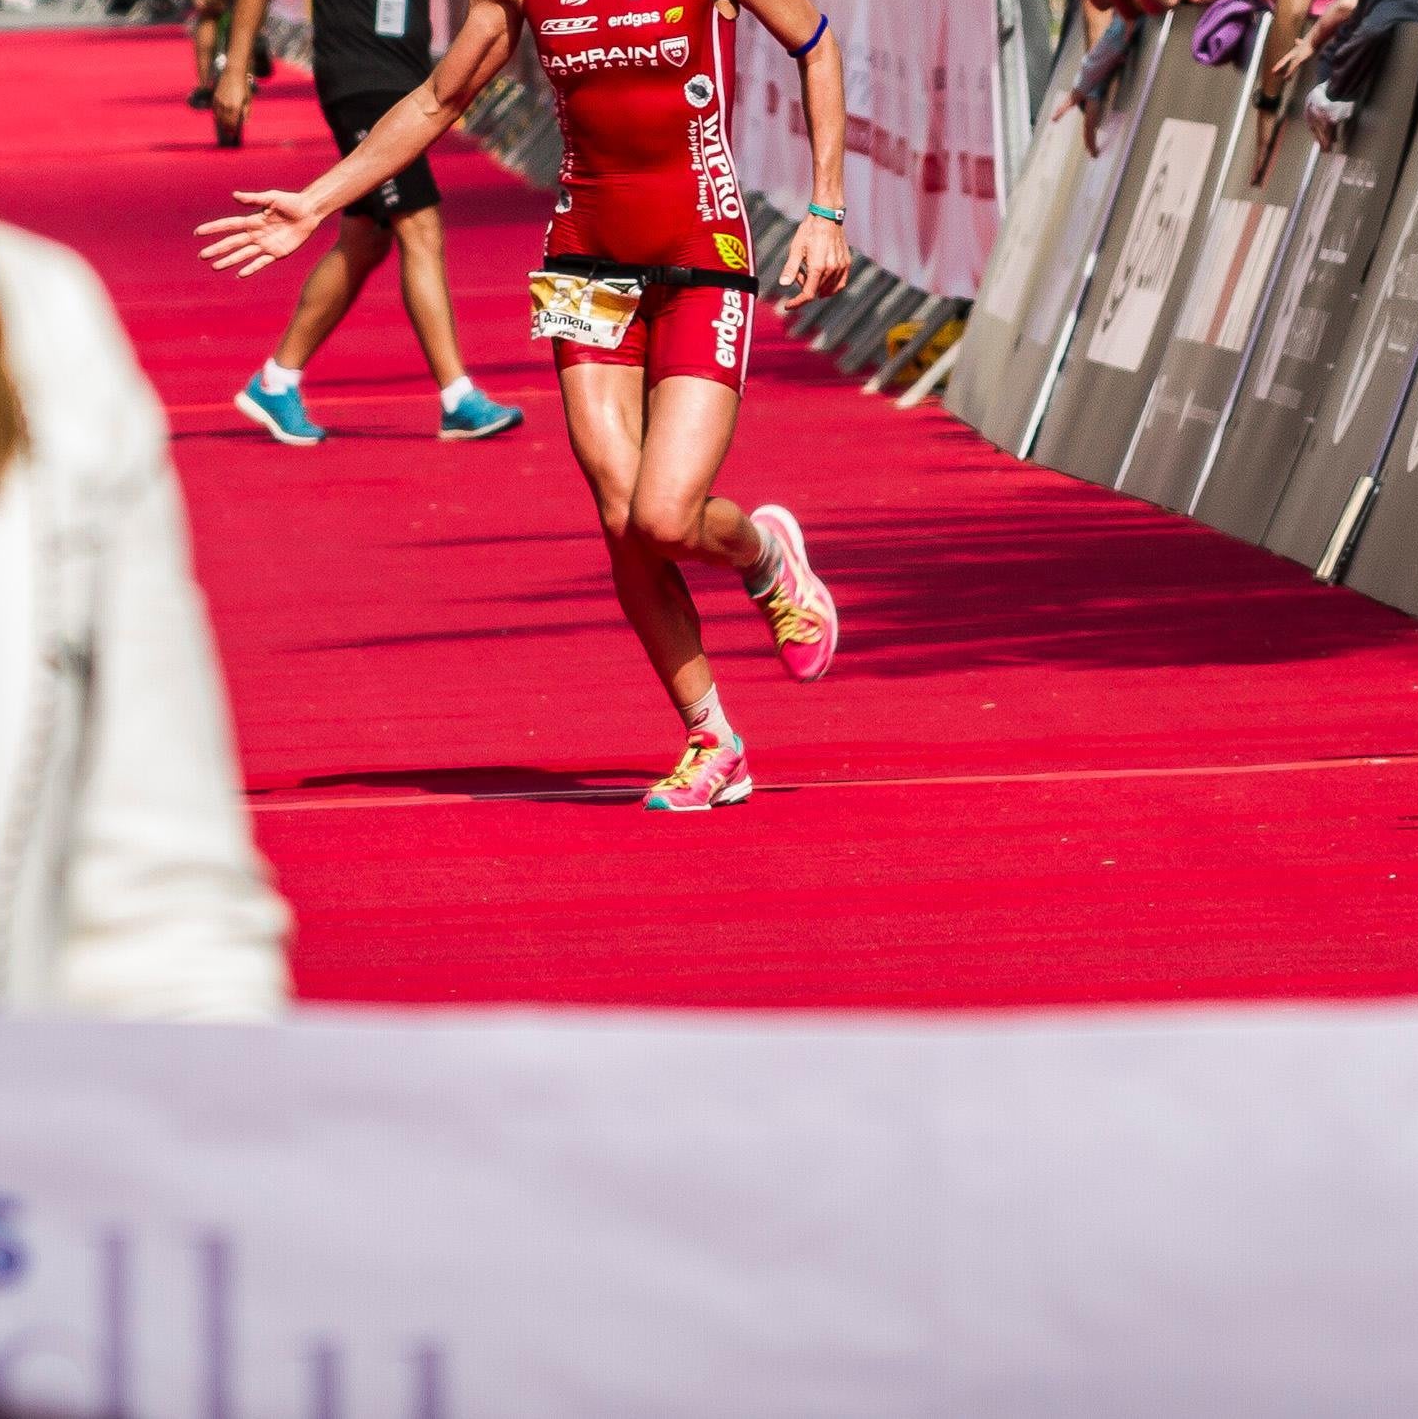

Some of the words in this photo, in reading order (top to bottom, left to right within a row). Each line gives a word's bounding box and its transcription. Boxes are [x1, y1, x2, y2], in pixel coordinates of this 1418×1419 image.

[608, 11, 660, 27] erdgas
[541, 45, 657, 68] BAHRAIN
[548, 59, 659, 76] NDURANCE
[688, 120, 703, 170] Applying
[702, 111, 741, 220] WIPRO
[695, 174, 714, 222] Thought
[544, 311, 592, 332] Daniela
[711, 288, 744, 369] erdga
